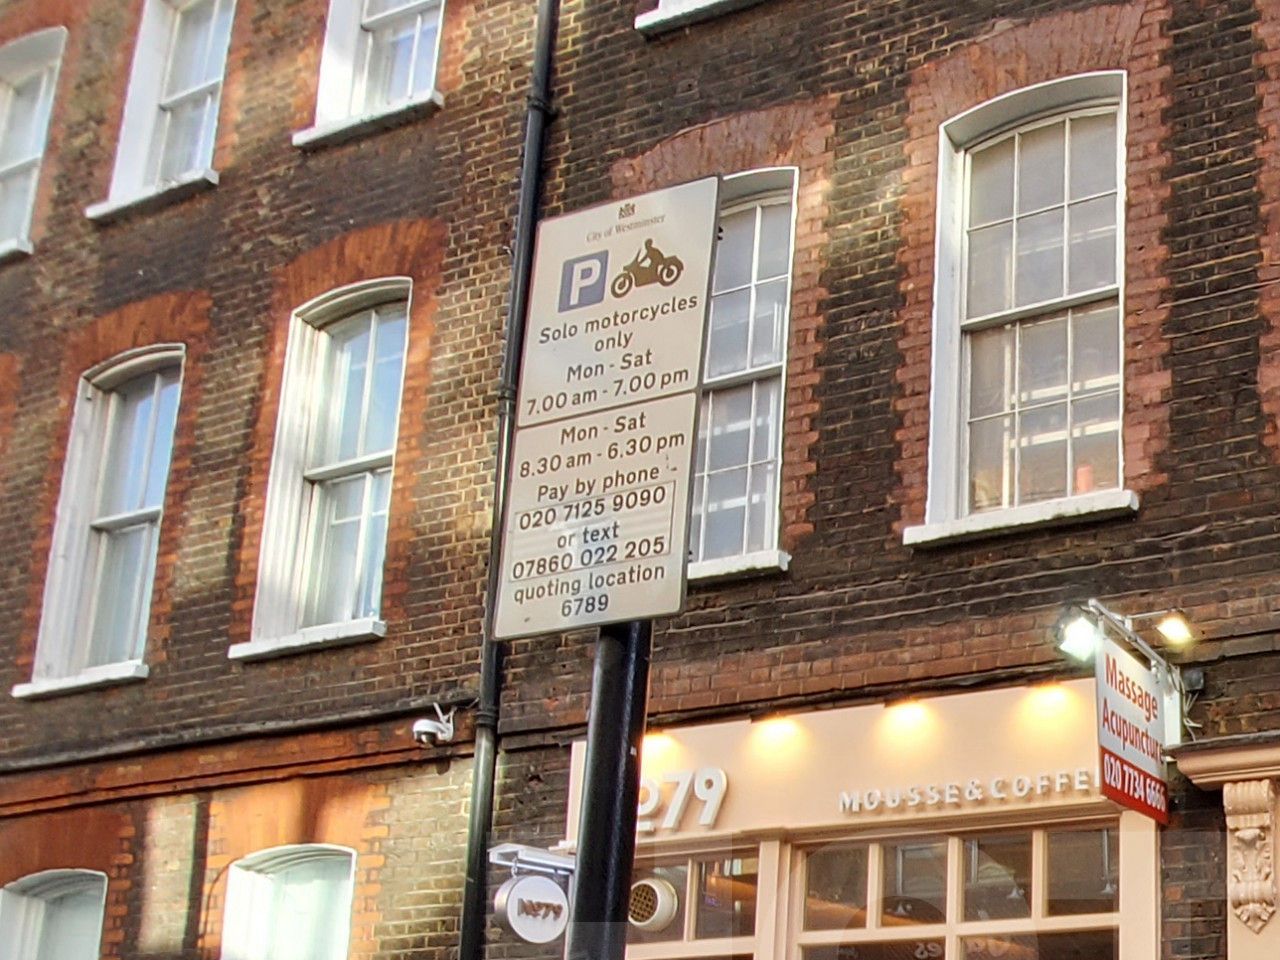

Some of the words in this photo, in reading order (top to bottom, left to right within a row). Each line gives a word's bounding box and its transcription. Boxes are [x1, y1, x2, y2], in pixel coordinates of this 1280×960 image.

[570, 259, 601, 305] P
[539, 323, 578, 344] Solo
[585, 295, 698, 333] motorcycles
[595, 331, 633, 352] only
[567, 364, 604, 383] Mon
[620, 349, 653, 371] Sat
[527, 394, 567, 416] 7.00
[572, 389, 597, 405] am
[613, 373, 656, 397] 7.00
[660, 369, 689, 389] pm
[560, 426, 598, 445] Mon
[614, 412, 646, 433] Sat
[520, 454, 561, 478] 8.30
[566, 452, 591, 469] am
[608, 435, 652, 460] 6.30
[656, 432, 685, 451] pm
[537, 483, 568, 503] Pay
[575, 477, 596, 496] by
[602, 466, 659, 493] phone
[519, 508, 556, 530] 020
[564, 498, 605, 522] 7125
[612, 485, 666, 512] 9090
[557, 532, 576, 548] or
[582, 521, 620, 544] text
[513, 552, 573, 580] 07860
[580, 544, 618, 567] 022
[624, 535, 665, 559] 205
[514, 578, 581, 605] quoting
[588, 564, 665, 590] location
[561, 594, 609, 617] 6789
[1105, 653, 1158, 722] Massage
[1103, 698, 1164, 766] Acupuncture
[1104, 753, 1121, 791] 020
[1122, 765, 1145, 802] 7734
